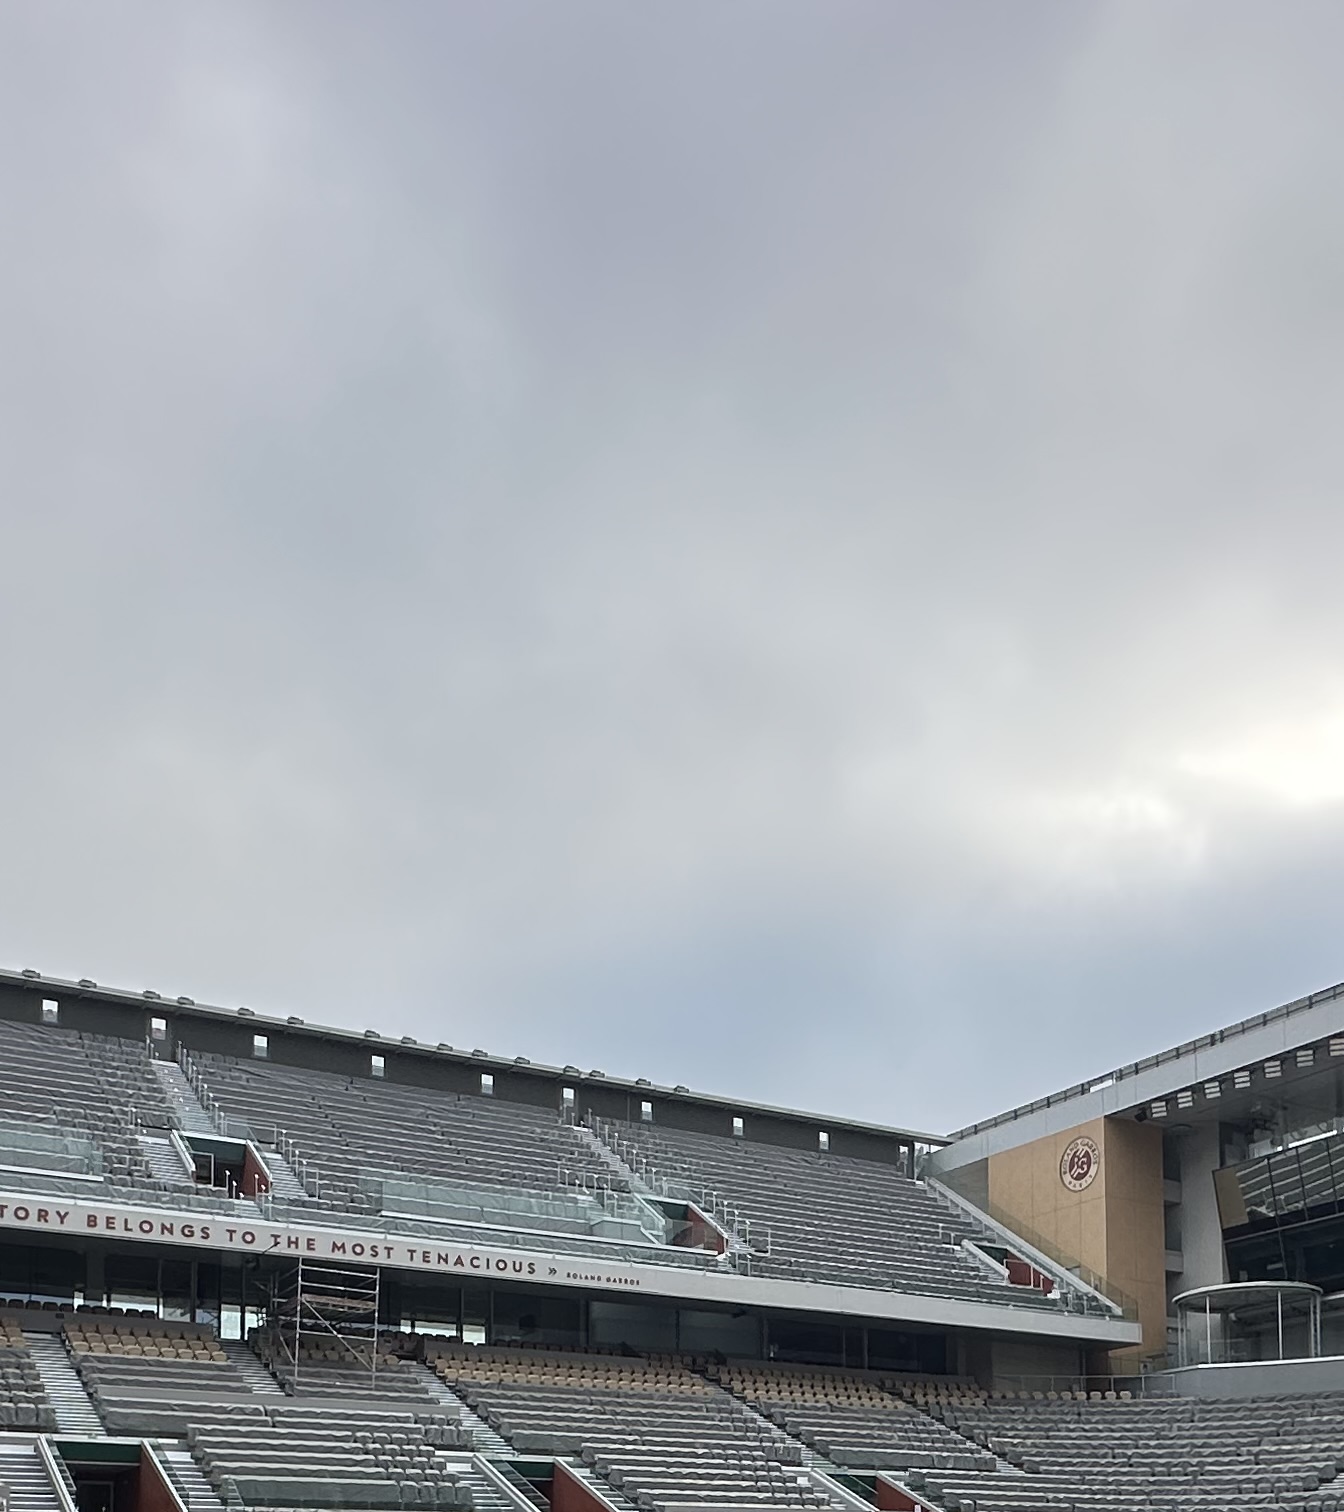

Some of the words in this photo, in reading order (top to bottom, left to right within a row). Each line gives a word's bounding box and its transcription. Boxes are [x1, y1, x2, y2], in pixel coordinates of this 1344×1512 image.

[87, 1214, 210, 1240] BELONGS
[226, 1228, 256, 1244] TO
[270, 1233, 316, 1251] THE
[331, 1240, 394, 1259] MOST
[407, 1249, 537, 1275] TENACIOUS
